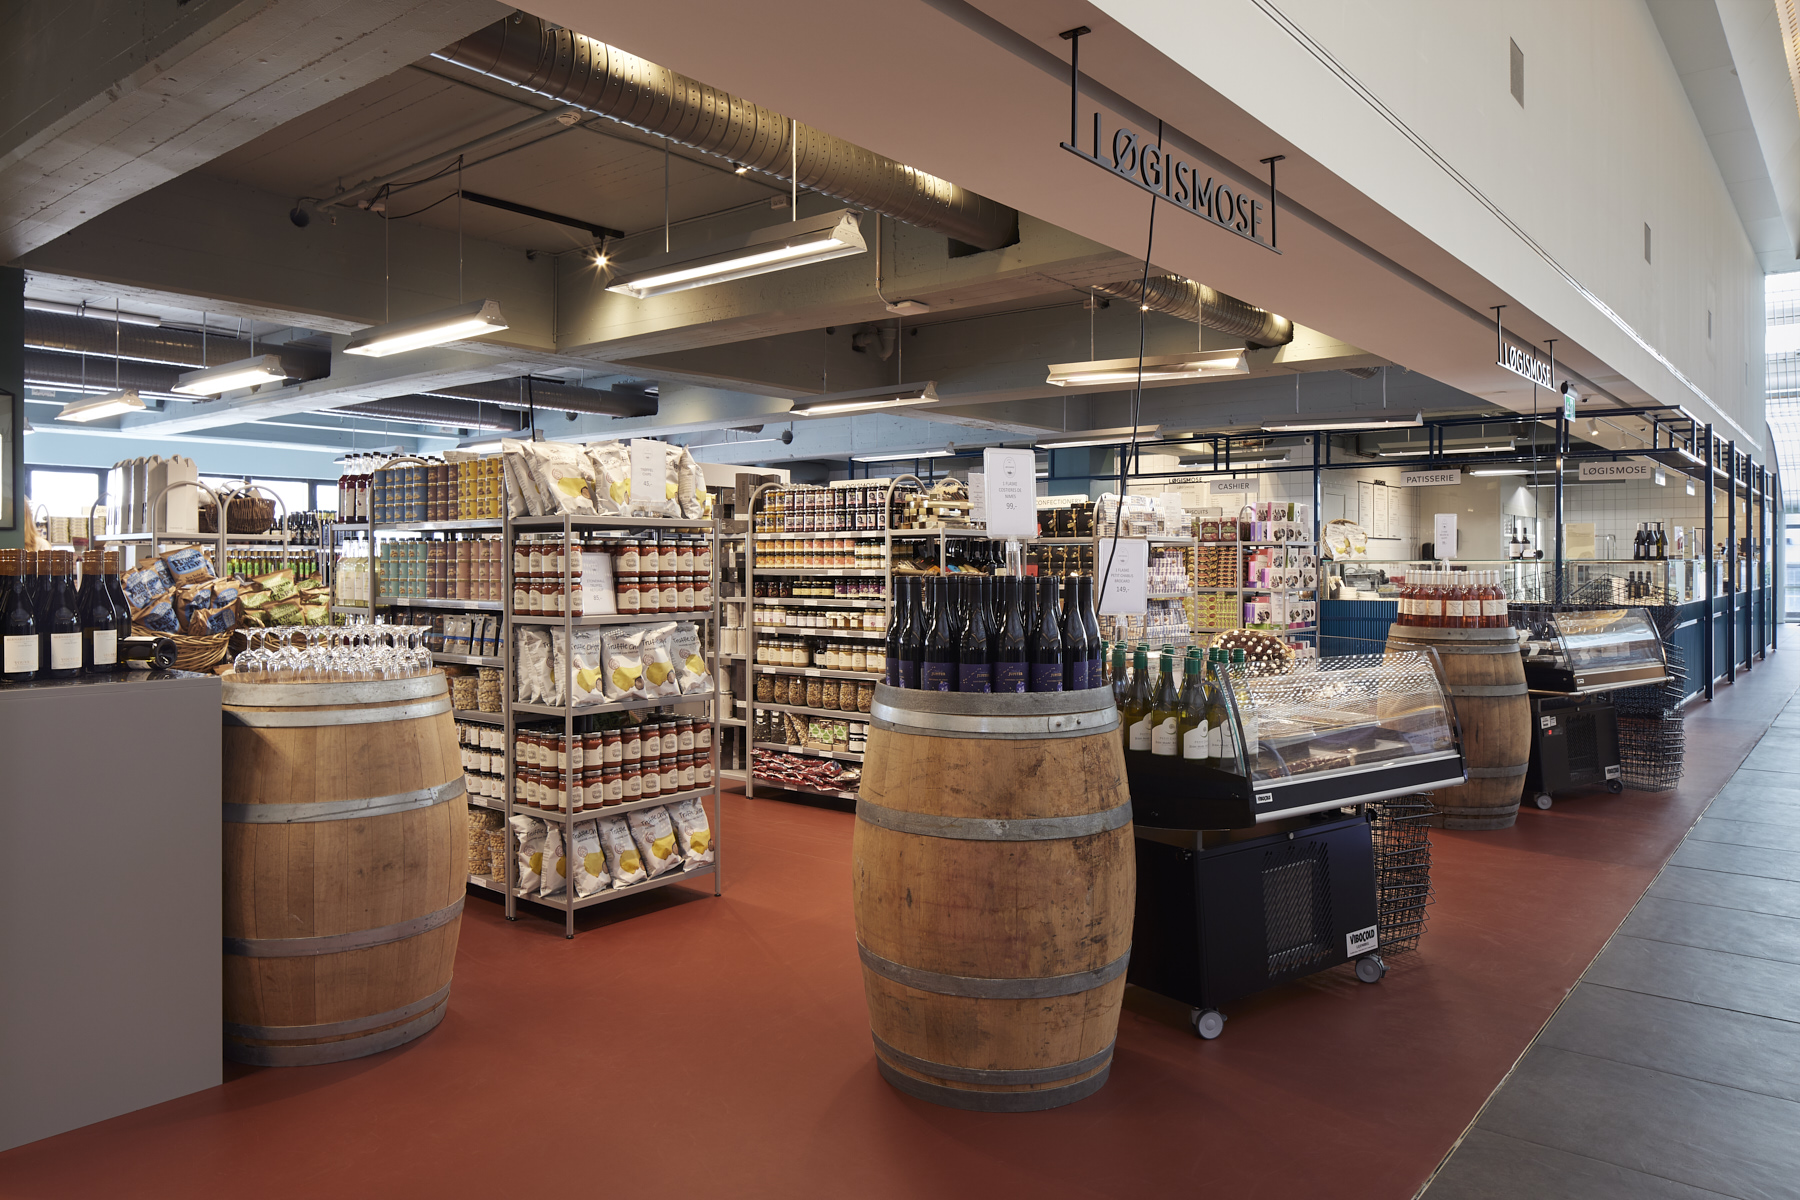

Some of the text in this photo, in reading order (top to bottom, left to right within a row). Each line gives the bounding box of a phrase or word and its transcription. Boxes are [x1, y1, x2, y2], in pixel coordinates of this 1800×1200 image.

[1093, 112, 1264, 243] LØGISMOSE
[1503, 342, 1551, 388] LØGISMOSE
[1582, 466, 1647, 475] LØGISMOSE
[1406, 474, 1454, 483] PATISSERIE
[1006, 502, 1017, 510] 99,-
[1349, 929, 1375, 945] VIBOCOLD
